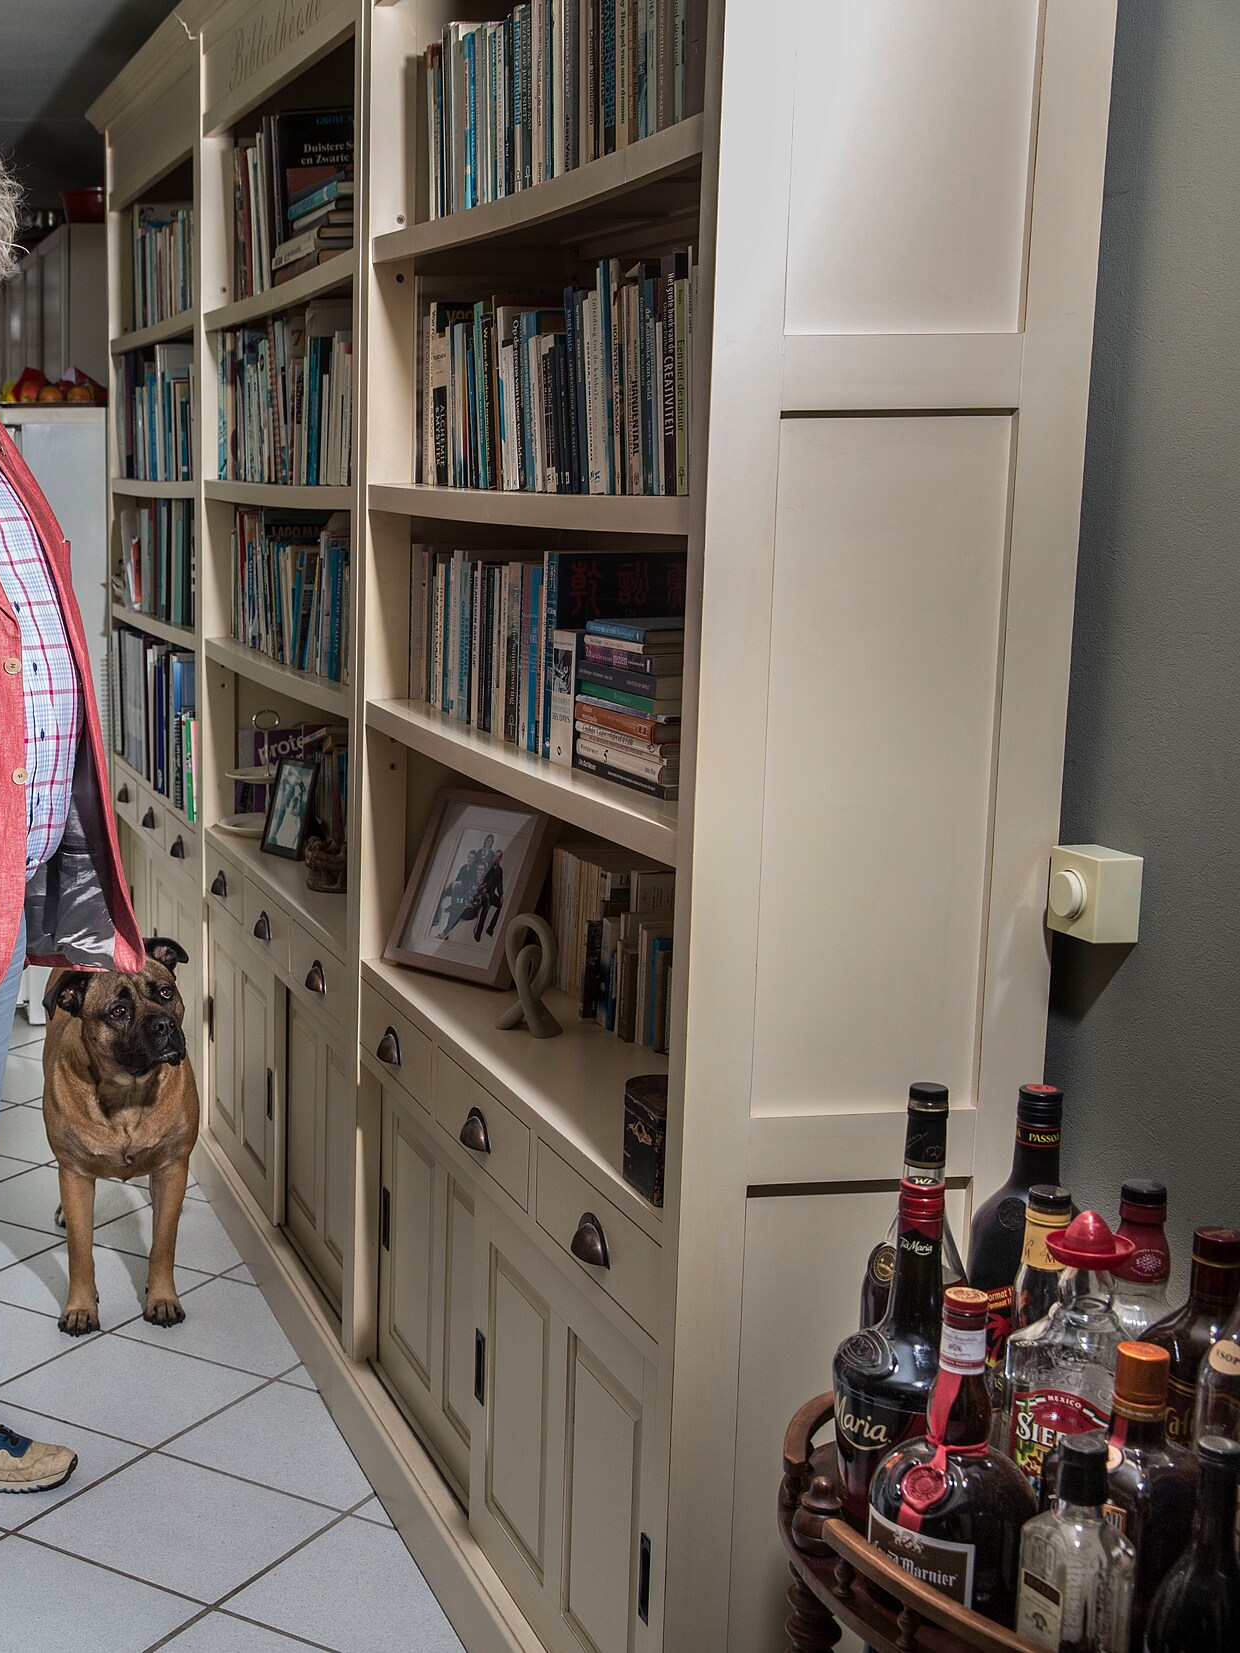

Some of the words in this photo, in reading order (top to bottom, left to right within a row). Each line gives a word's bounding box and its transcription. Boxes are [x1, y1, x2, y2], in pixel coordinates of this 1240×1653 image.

[303, 143, 345, 154] Duistere
[301, 157, 313, 166] en
[315, 153, 350, 165] Zwarte
[513, 319, 519, 335] Op
[677, 339, 685, 359] Een
[664, 355, 674, 436] CREATIVITEIT
[303, 525, 324, 537] MA
[909, 1240, 933, 1254] Maria
[1047, 1394, 1082, 1409] MEXICO
[833, 1390, 890, 1444] Maria
[901, 1557, 957, 1587] Marnier
